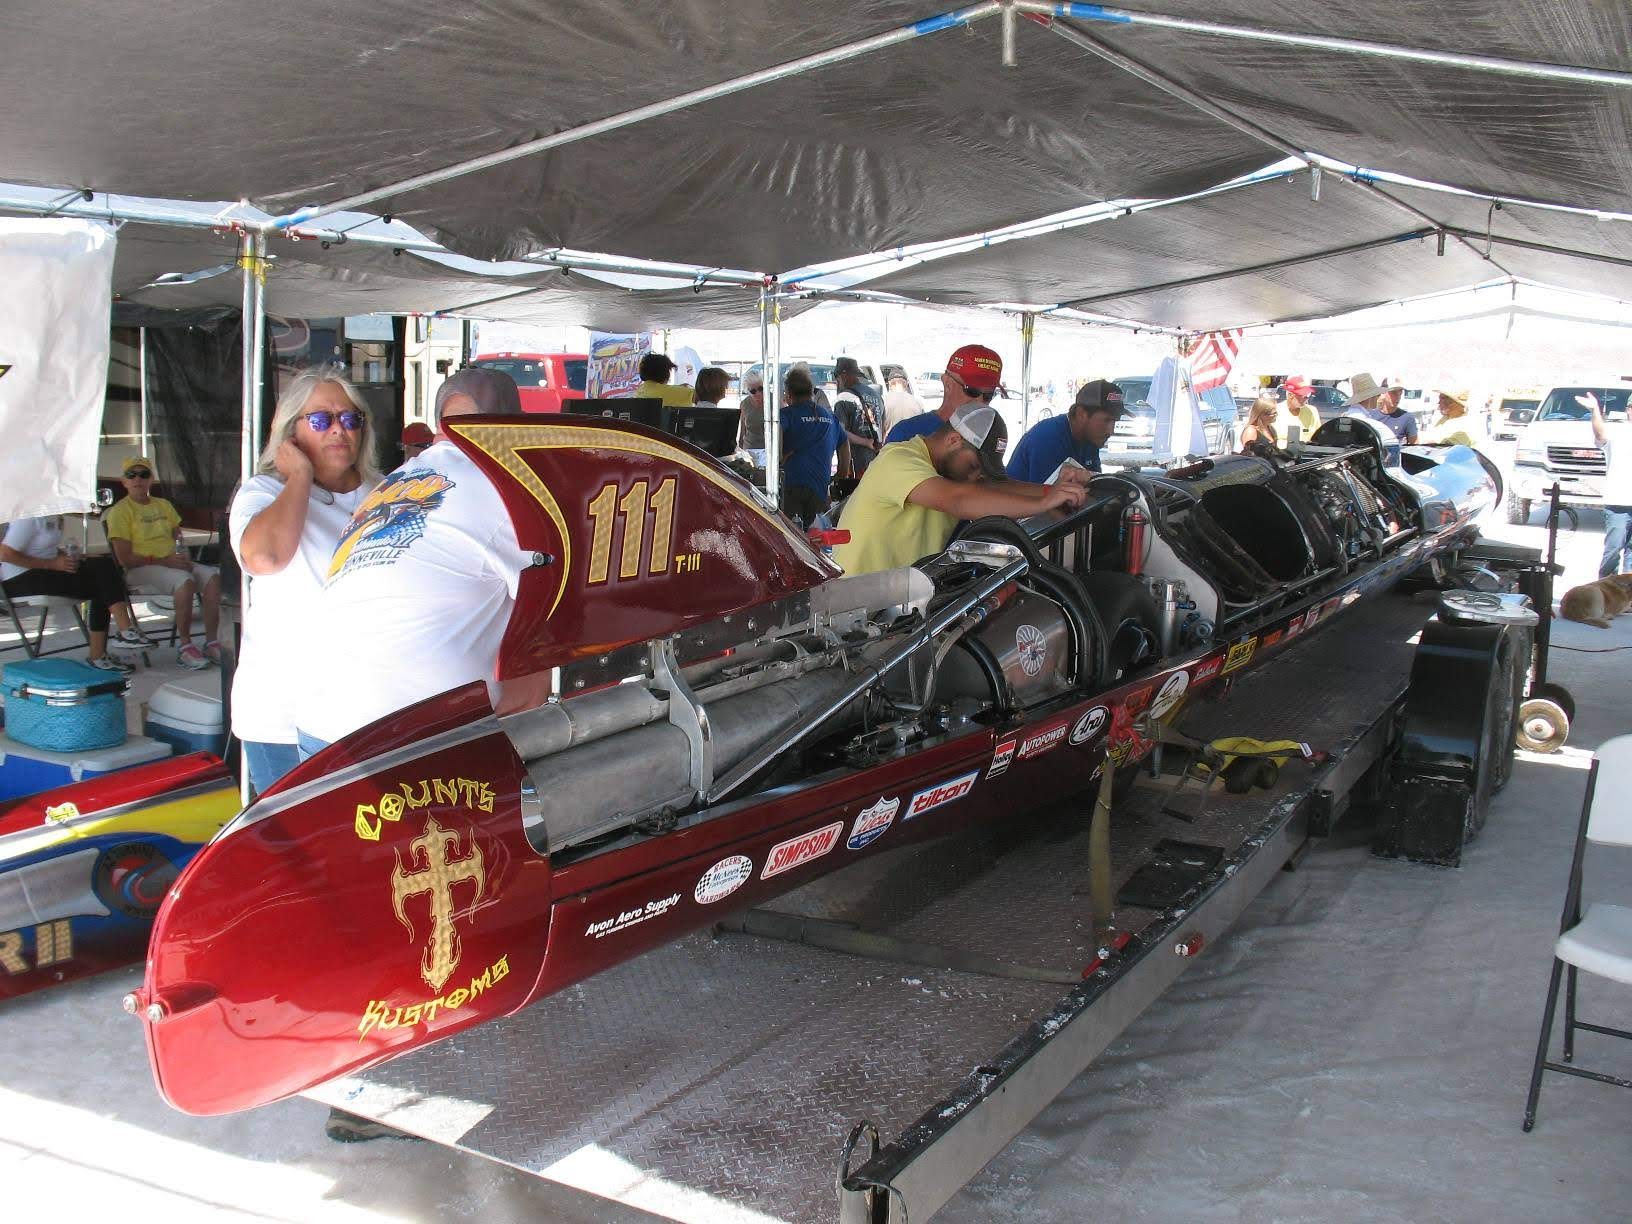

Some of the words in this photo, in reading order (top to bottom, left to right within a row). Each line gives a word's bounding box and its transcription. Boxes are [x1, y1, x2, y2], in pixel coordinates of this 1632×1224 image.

[588, 478, 676, 584] 111
[913, 780, 971, 814] tilton
[713, 856, 742, 873] RACERS
[769, 829, 837, 872] SIMPSON
[585, 918, 614, 937] Avon
[615, 908, 643, 925] Aero
[644, 893, 681, 914] Supply
